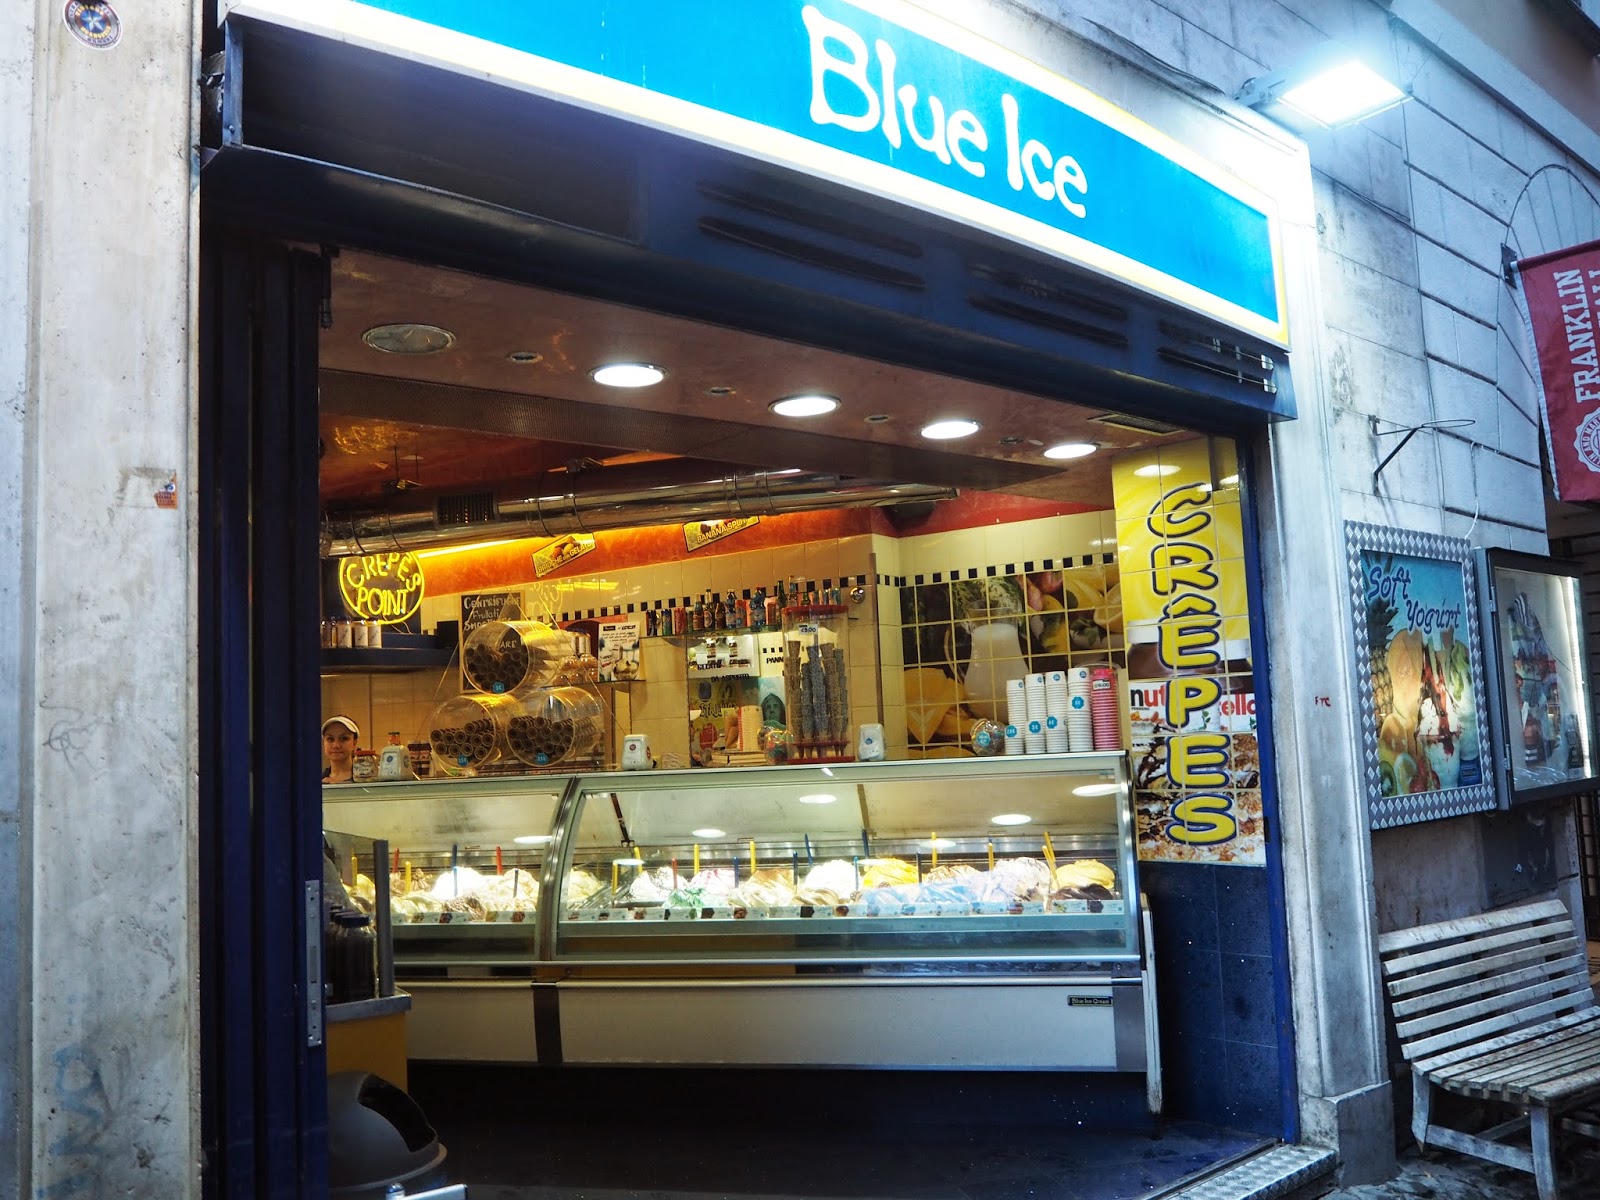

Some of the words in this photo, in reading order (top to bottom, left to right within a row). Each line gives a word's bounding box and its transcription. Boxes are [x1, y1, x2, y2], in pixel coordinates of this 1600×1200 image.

[802, 4, 988, 177] Blue
[1002, 94, 1088, 219] Ice
[1553, 269, 1600, 405] FRANKLIN
[697, 524, 727, 543] BANANA
[346, 553, 421, 592] CREPES
[1368, 566, 1411, 607] Soft
[357, 587, 409, 616] POINT
[1406, 599, 1461, 635] Yogurt
